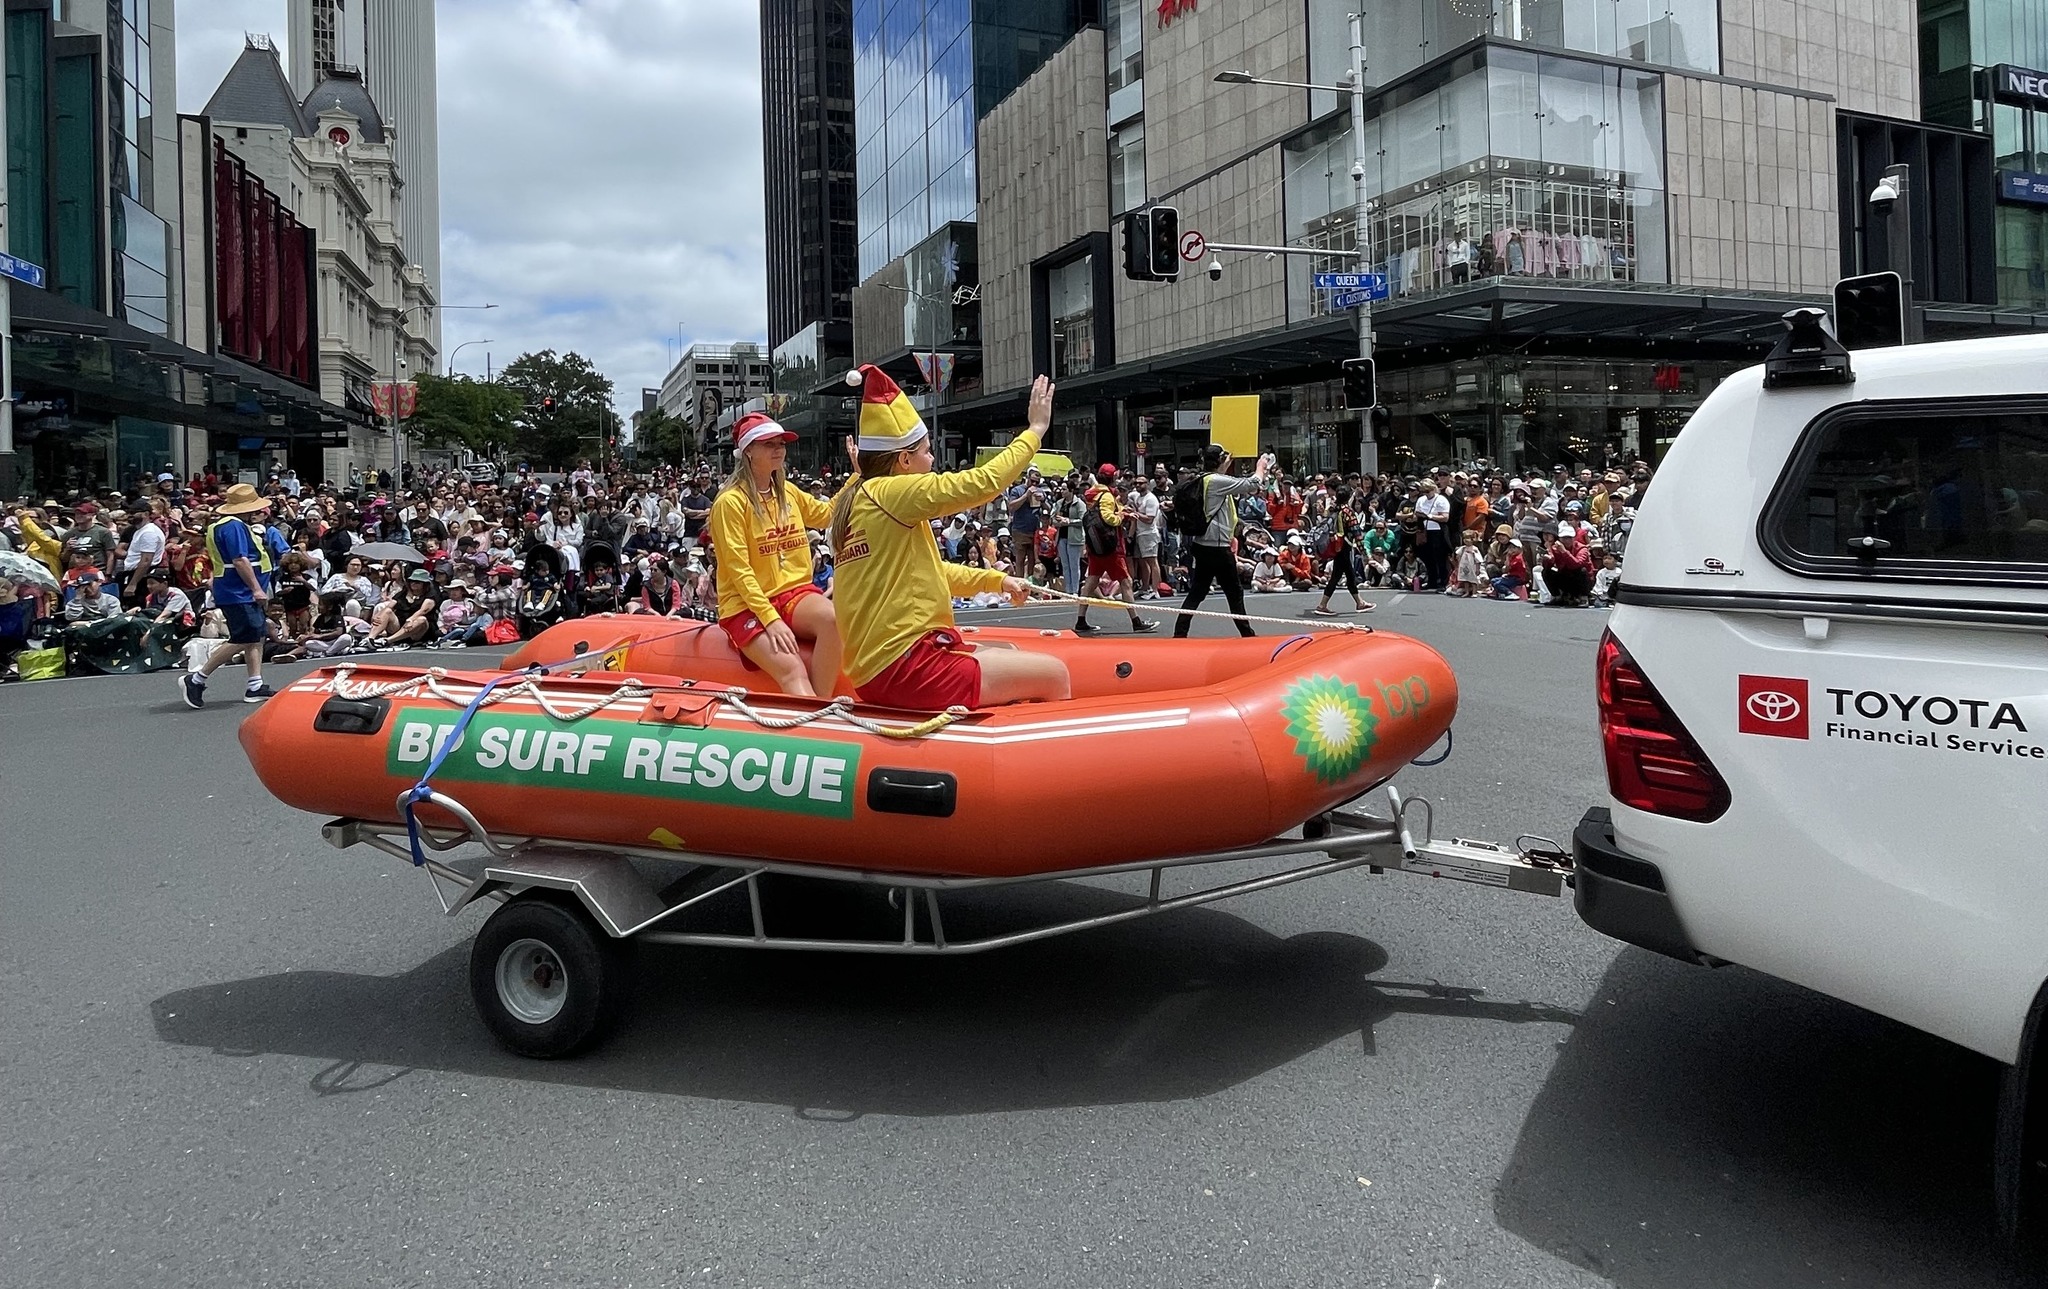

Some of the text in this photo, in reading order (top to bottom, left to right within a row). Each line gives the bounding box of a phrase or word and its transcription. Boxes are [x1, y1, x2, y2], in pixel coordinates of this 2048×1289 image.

[2009, 72, 2048, 98] NEC
[1335, 276, 1359, 286] QUEEN
[1346, 290, 1371, 304] CUSTOMS
[1374, 676, 1431, 721] bp
[1826, 688, 2028, 732] TOYOTA
[1826, 722, 2048, 759] Financial Service
[397, 722, 848, 803] BP SURF RESCUE
